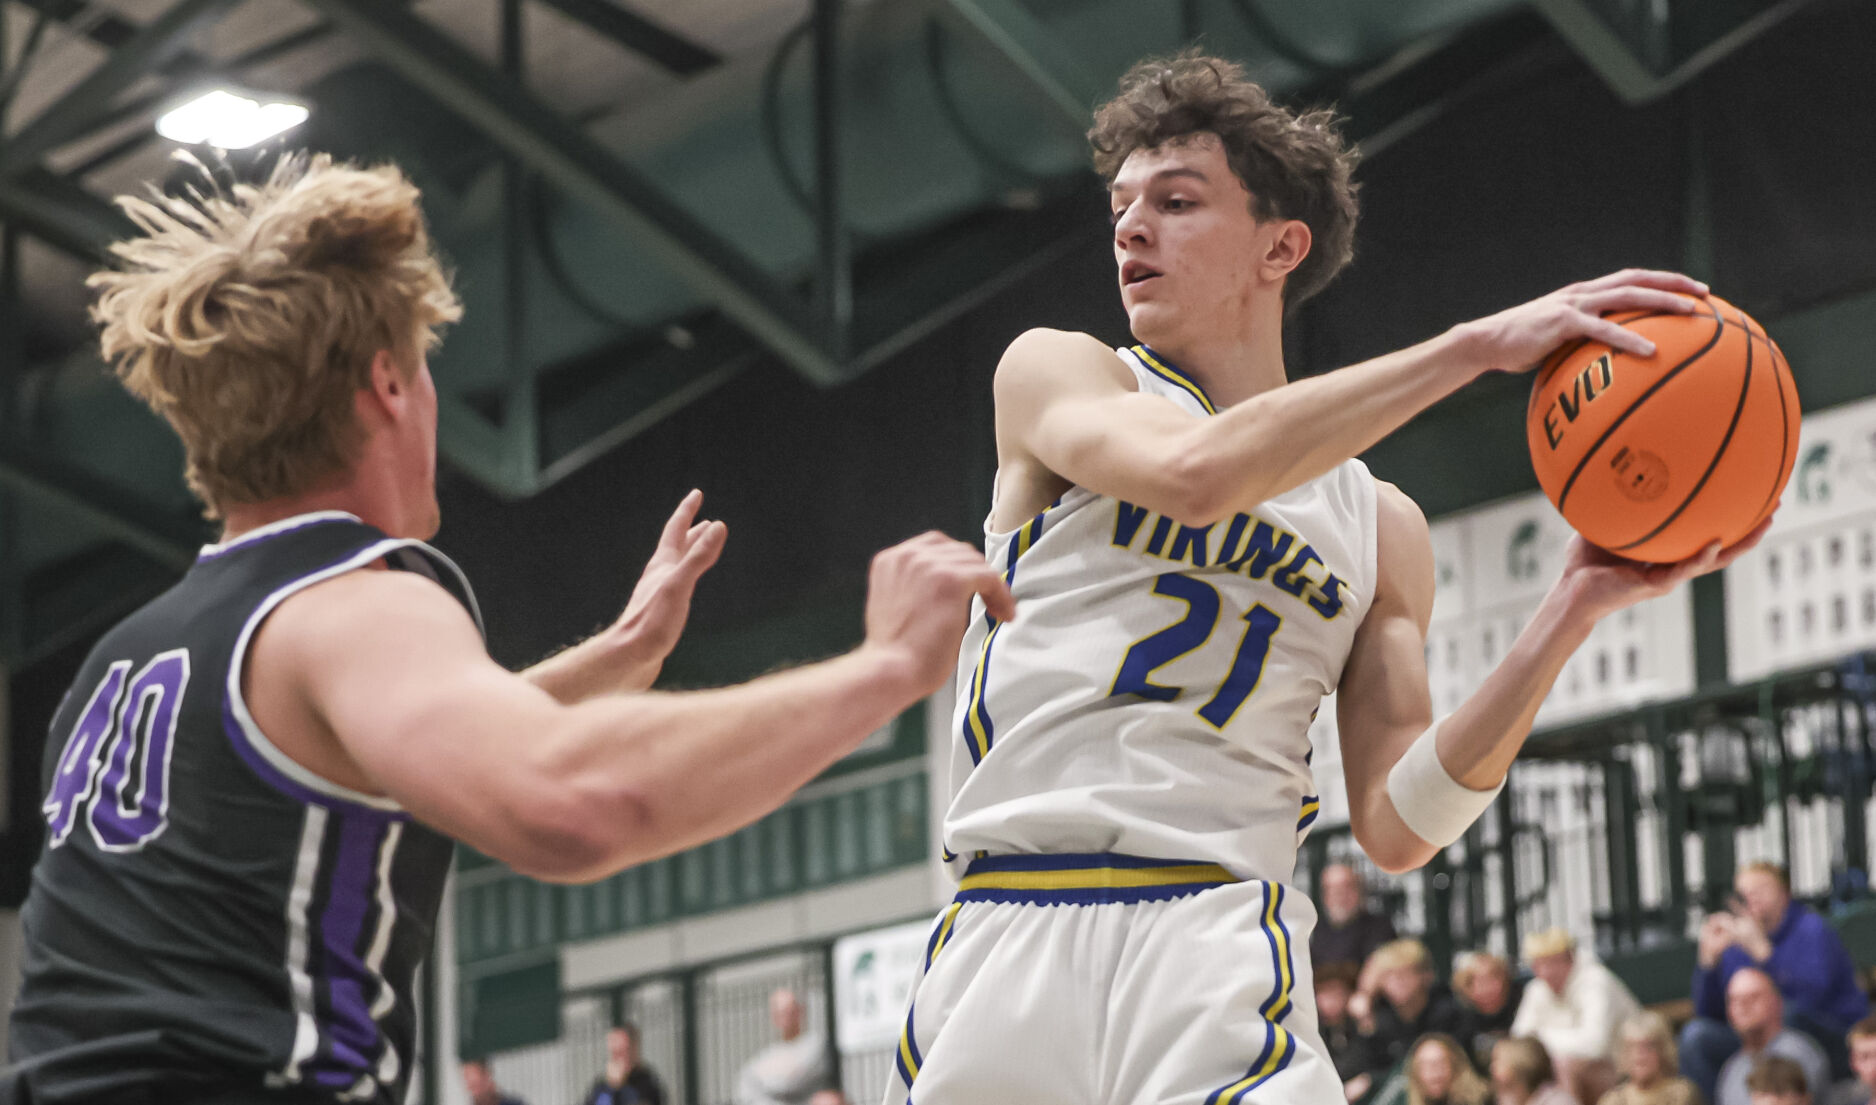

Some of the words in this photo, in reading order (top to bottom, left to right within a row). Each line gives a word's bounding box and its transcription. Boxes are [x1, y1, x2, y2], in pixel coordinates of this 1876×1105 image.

[1543, 351, 1614, 451] EVO
[1110, 499, 1348, 620] VIKINGS
[1107, 571, 1285, 733] 21
[42, 647, 191, 853] 40
